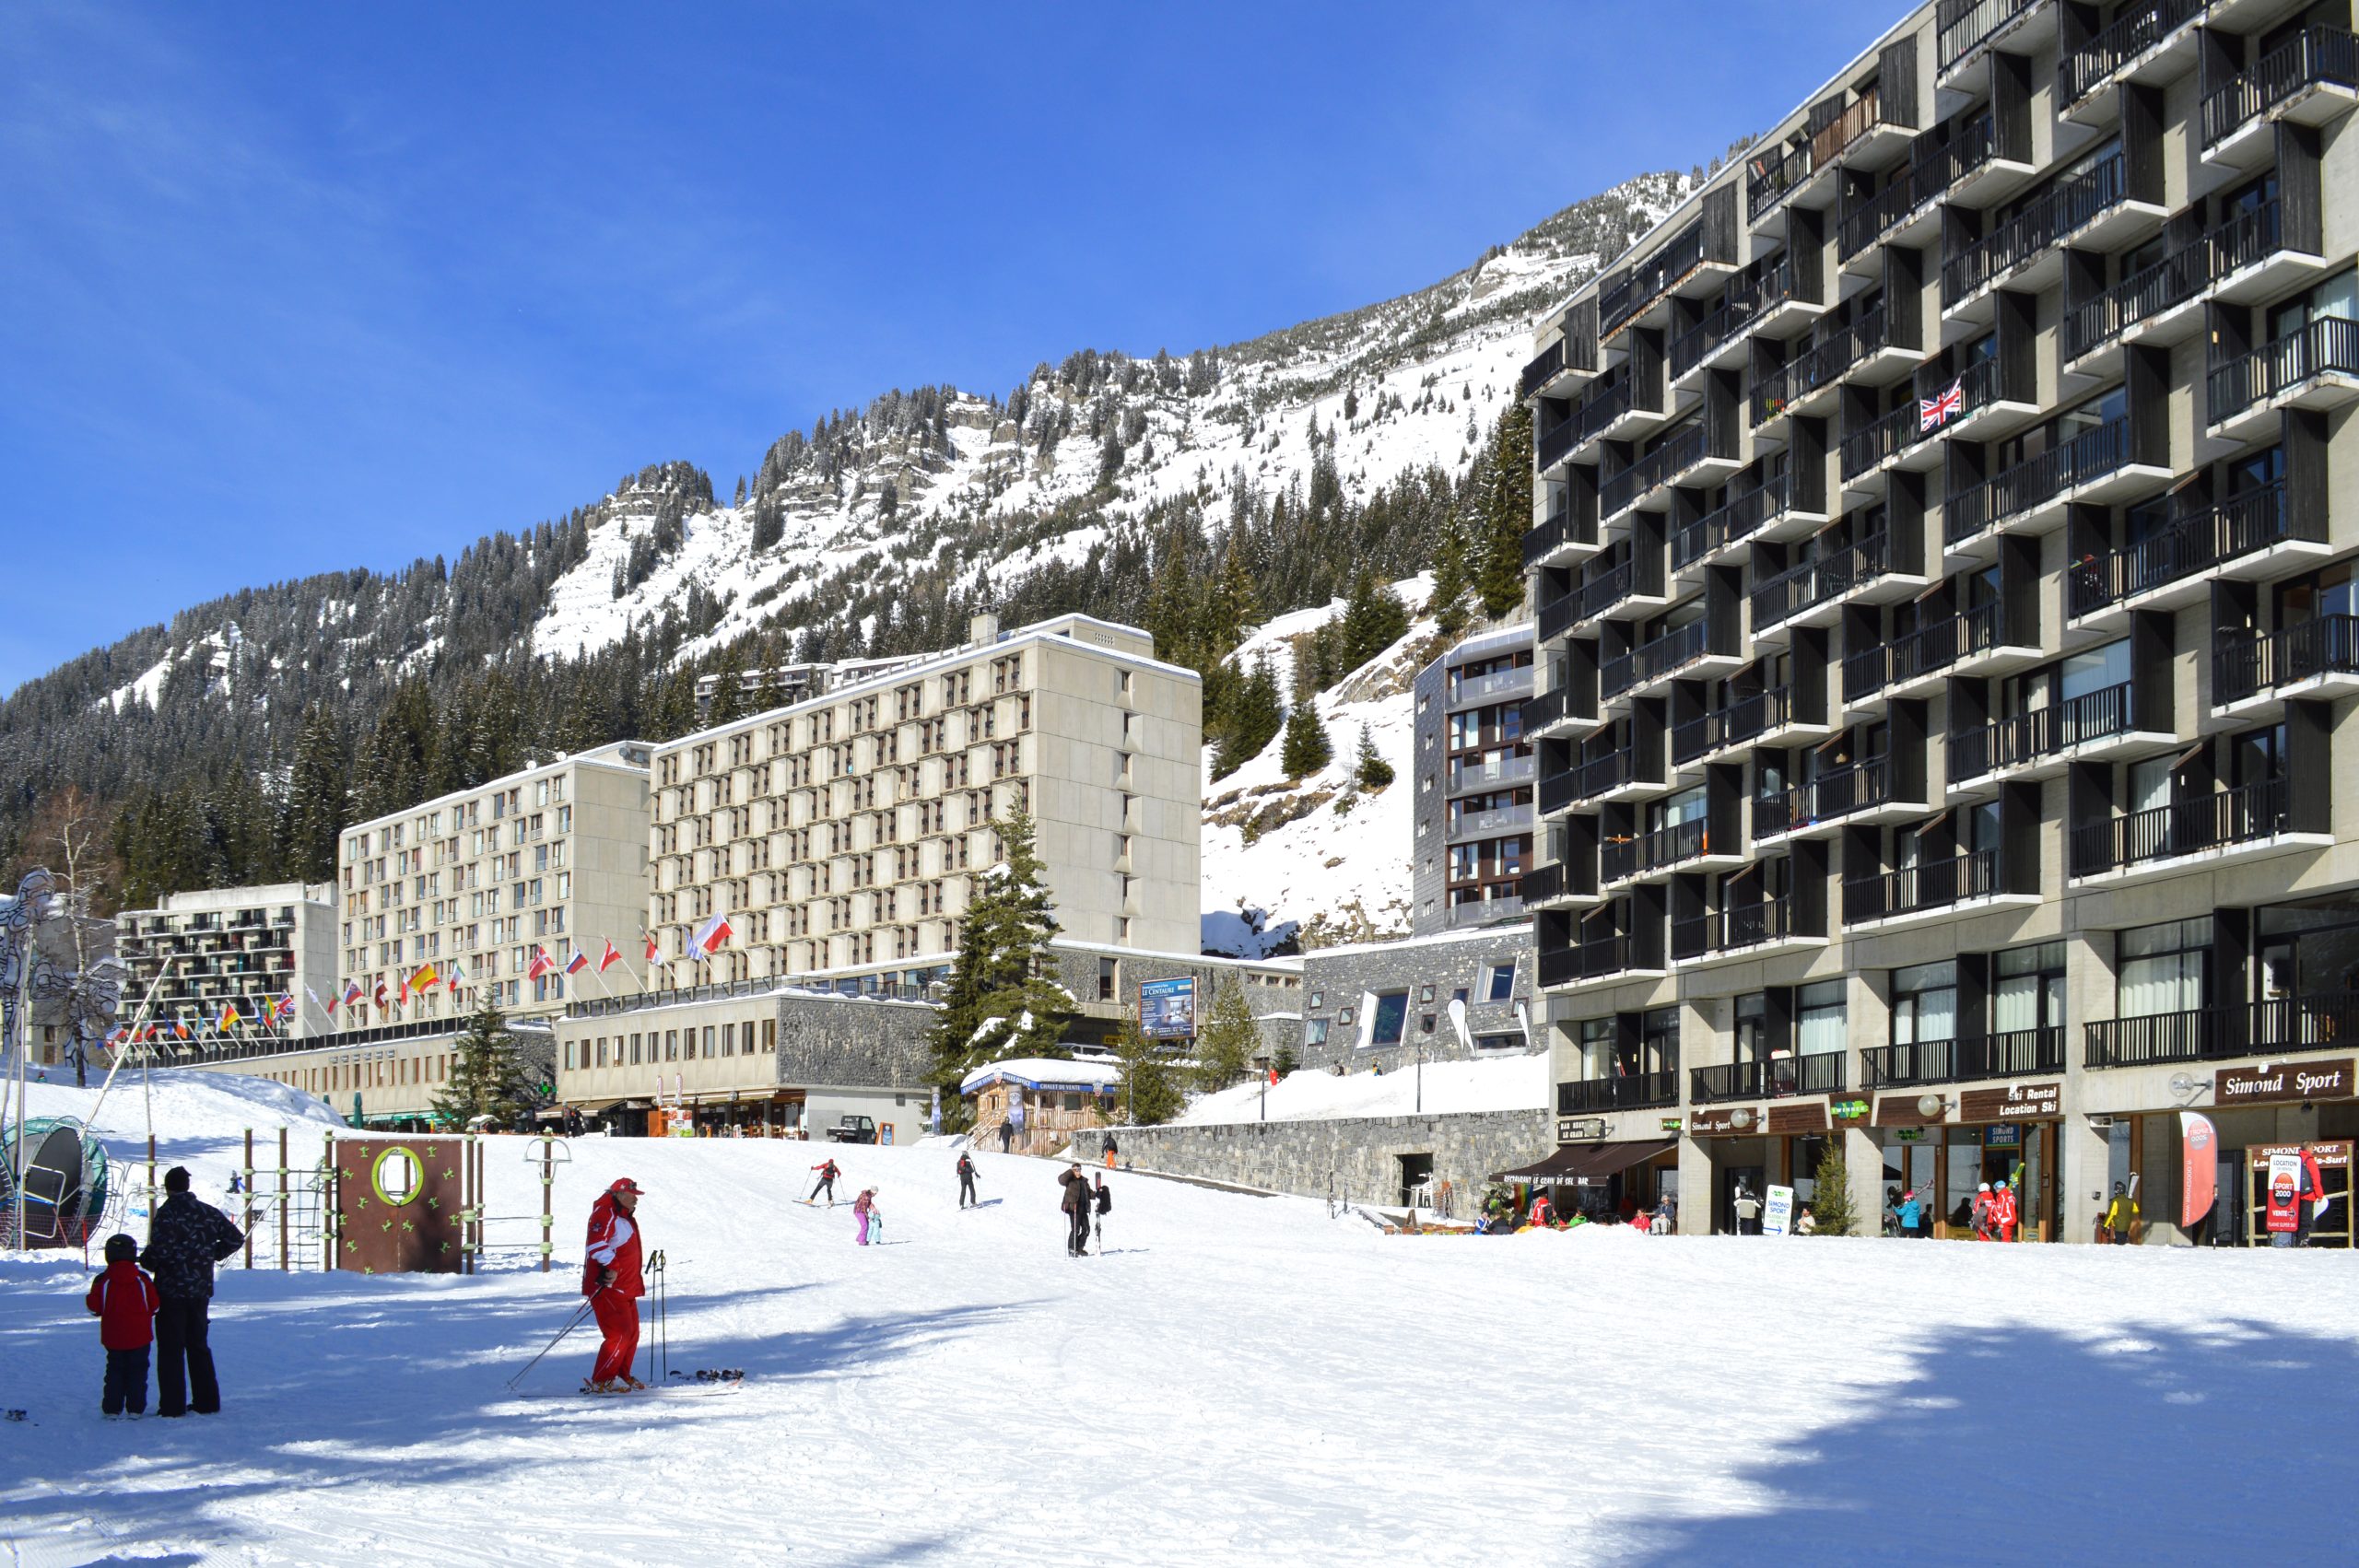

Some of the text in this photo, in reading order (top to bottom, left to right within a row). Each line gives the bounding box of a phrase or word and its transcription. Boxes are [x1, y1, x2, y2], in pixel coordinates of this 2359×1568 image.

[1149, 987, 1175, 995] CENTAURE
[2225, 1071, 2341, 1094] Simond Sport
[2008, 1087, 2057, 1101] Ski Rental
[2000, 1101, 2057, 1116] Location Ski
[1692, 1121, 1711, 1130] Simond
[1715, 1120, 1731, 1131] Sport
[1992, 1127, 2013, 1135] SIMOND
[1992, 1135, 2013, 1143] SPORTS
[2313, 1144, 2338, 1154] PORT
[1540, 1176, 1555, 1185] GRAIN
[2275, 1189, 2291, 1198] 2000
[1768, 1200, 1790, 1209] SIMOND
